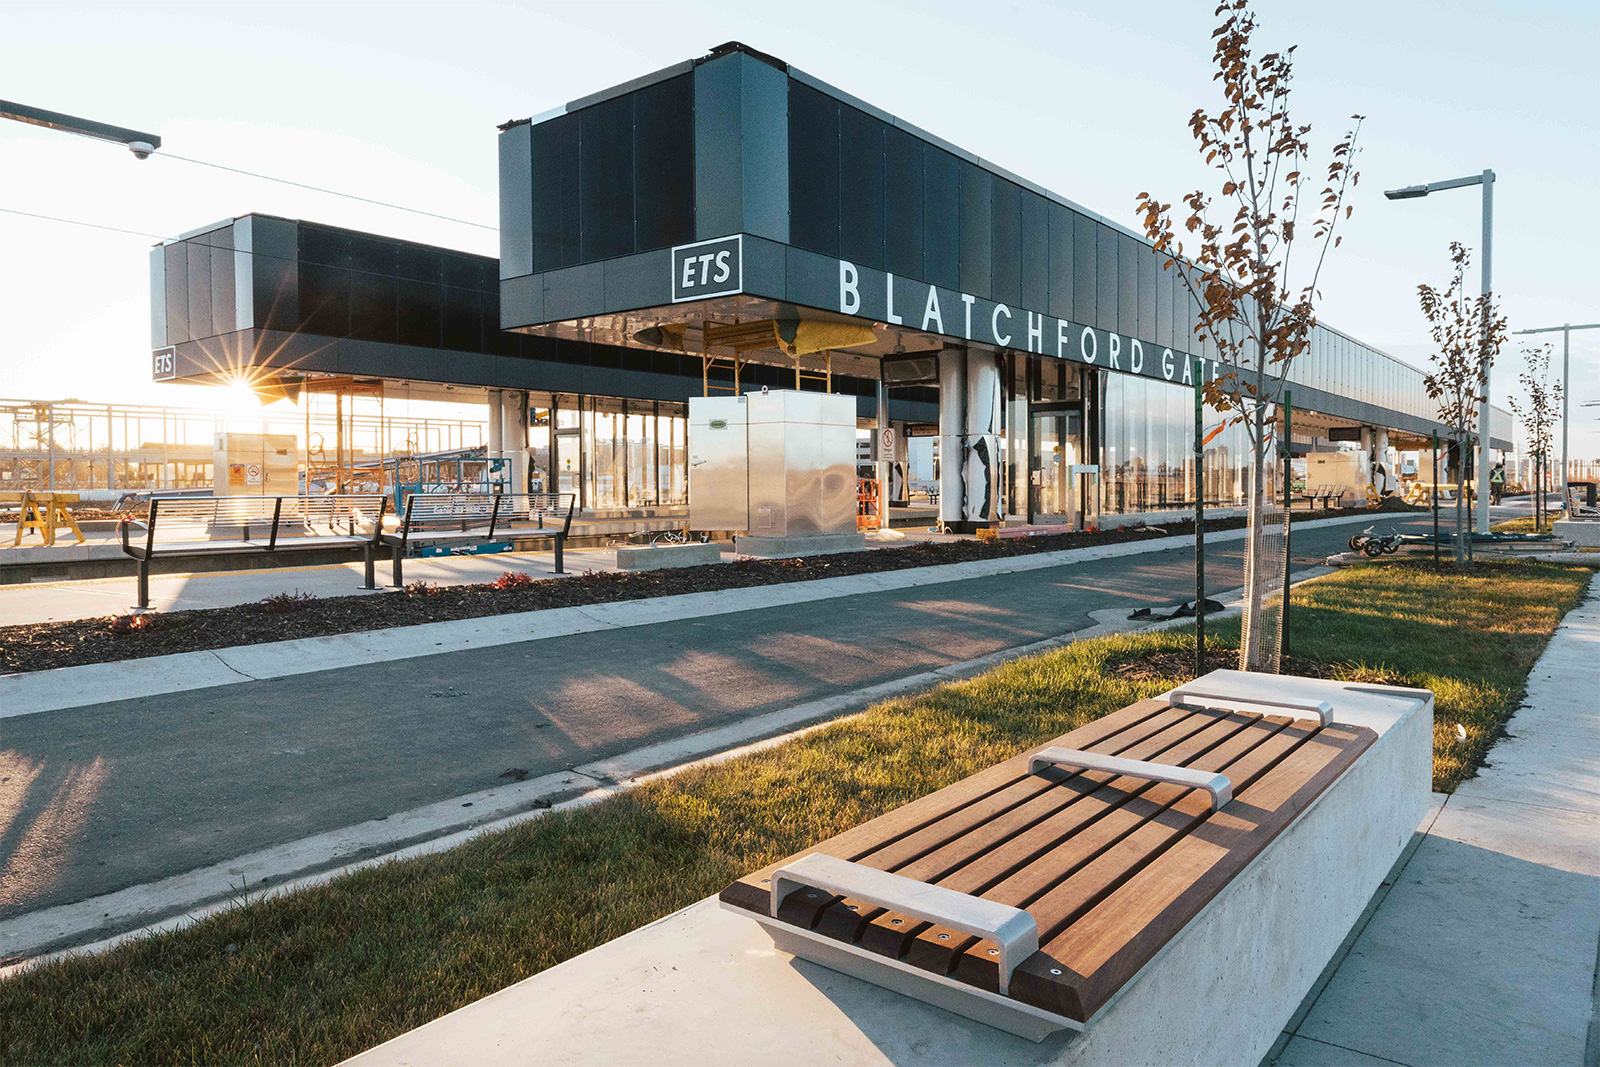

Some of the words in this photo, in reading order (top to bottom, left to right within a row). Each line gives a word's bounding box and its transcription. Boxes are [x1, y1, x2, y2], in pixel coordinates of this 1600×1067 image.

[681, 250, 731, 288] ETS
[839, 259, 1144, 374] BLATCHFORD
[1162, 348, 1220, 387] GATE
[155, 354, 172, 373] ETS
